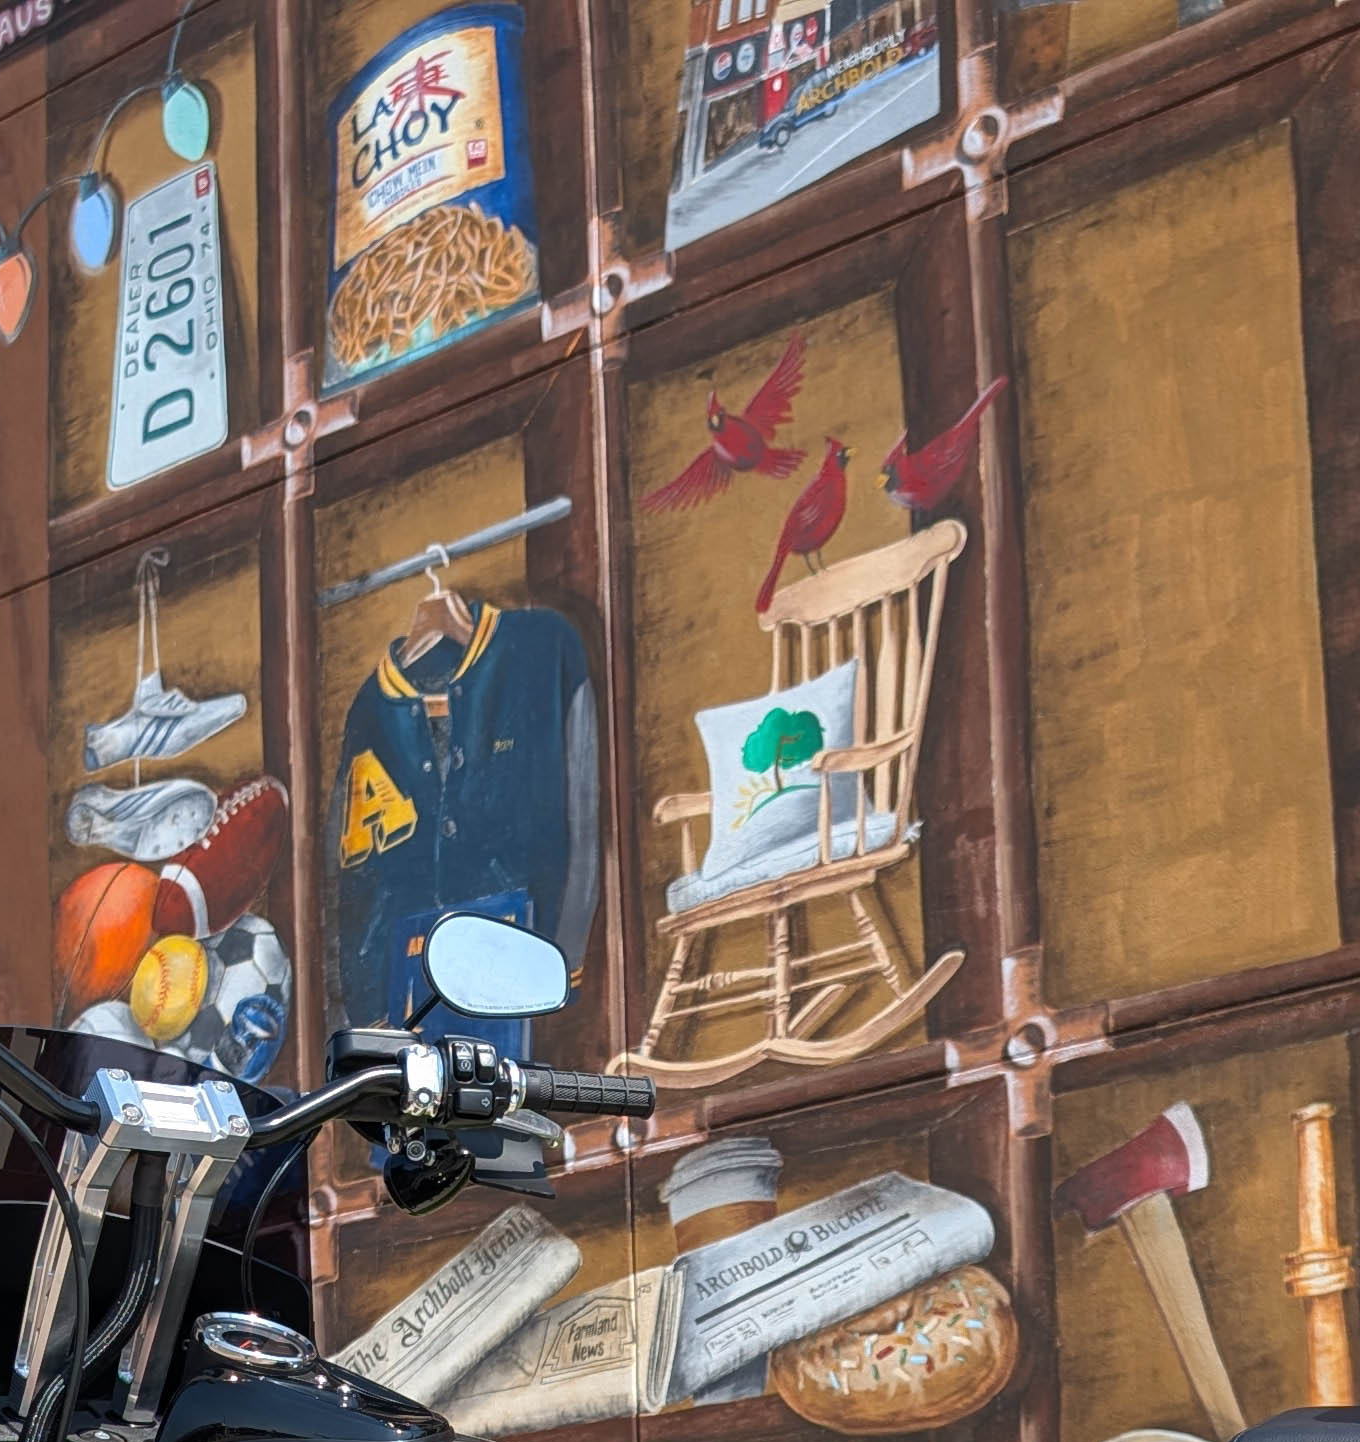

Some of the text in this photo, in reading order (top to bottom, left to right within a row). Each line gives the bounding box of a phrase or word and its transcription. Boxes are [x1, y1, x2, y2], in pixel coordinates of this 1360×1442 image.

[351, 97, 395, 145] LA
[795, 46, 905, 116] ARCHBOLD
[352, 95, 460, 189] CHOY
[124, 263, 143, 379] DEALER
[142, 211, 196, 445] D 2601
[202, 275, 218, 352] OHIO
[340, 749, 418, 868] A
[694, 1246, 786, 1302] ARCHBOLD
[809, 1194, 889, 1243] BUCKEYE
[344, 1341, 390, 1377] The
[391, 1254, 476, 1349] Archbold
[566, 1311, 618, 1344] Farmland
[571, 1339, 605, 1363] News
